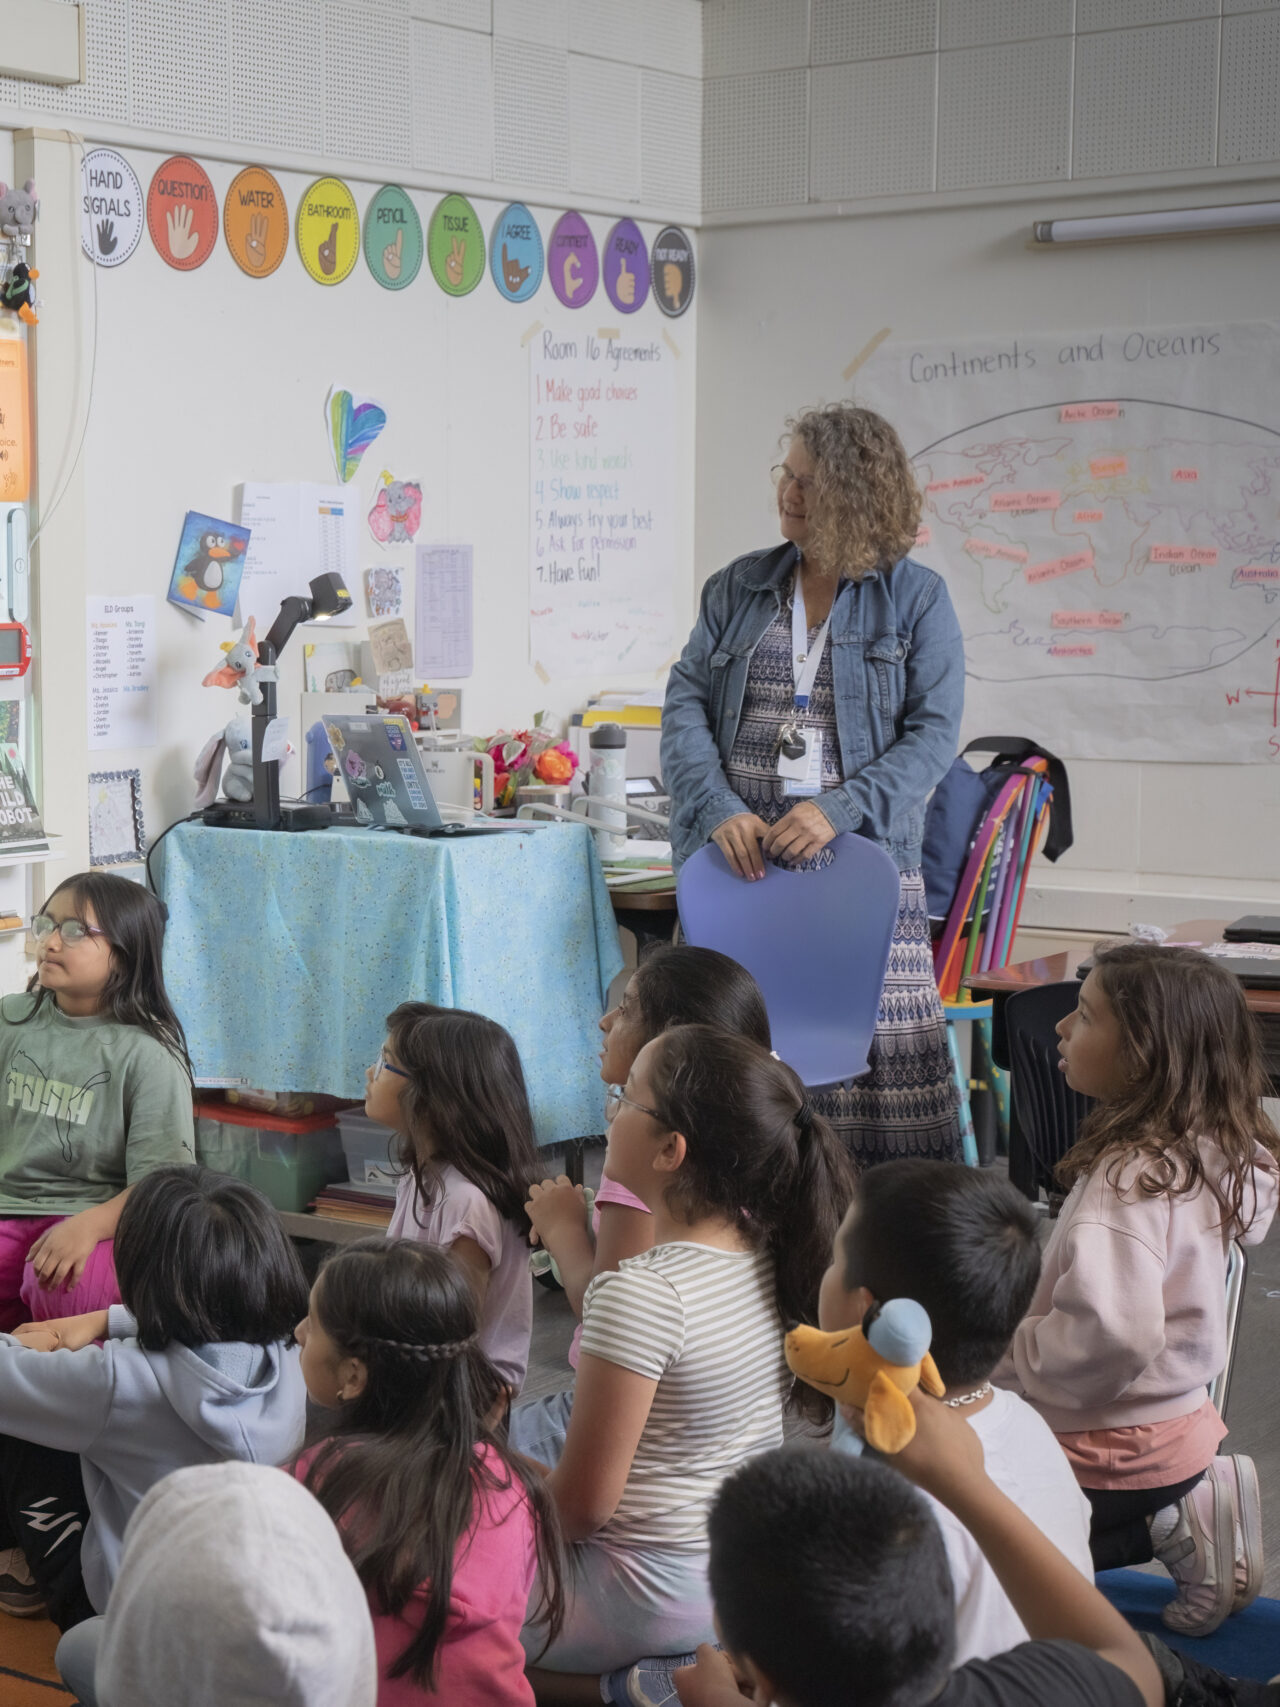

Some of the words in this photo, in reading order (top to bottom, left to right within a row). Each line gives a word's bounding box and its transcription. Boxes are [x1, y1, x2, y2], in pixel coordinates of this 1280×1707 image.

[89, 168, 123, 190] HAND
[157, 179, 208, 202] QUESTION
[237, 190, 275, 209] WATER
[83, 195, 131, 218] SIGNALS
[307, 203, 352, 220] BATHROOM
[376, 207, 408, 225] PENCIL
[443, 214, 470, 234] TISSUE
[506, 223, 532, 241] AGREE
[556, 234, 588, 249] COMMENT
[615, 237, 640, 255] READY
[543, 329, 578, 361] Room
[586, 335, 601, 361] 16
[605, 337, 662, 372] Agreements
[909, 340, 1037, 384] Continents
[1058, 335, 1104, 364] and
[1123, 331, 1221, 363] Oceans
[545, 377, 572, 402] Make
[578, 377, 601, 413] good
[550, 413, 567, 440] Be
[573, 414, 598, 440] safe
[548, 509, 584, 538] Always
[587, 508, 605, 538] try
[548, 534, 566, 553] Ask
[548, 560, 574, 585] Have
[577, 552, 601, 582] fun!
[1226, 688, 1240, 706] W
[6, 1071, 95, 1126] PUMA
